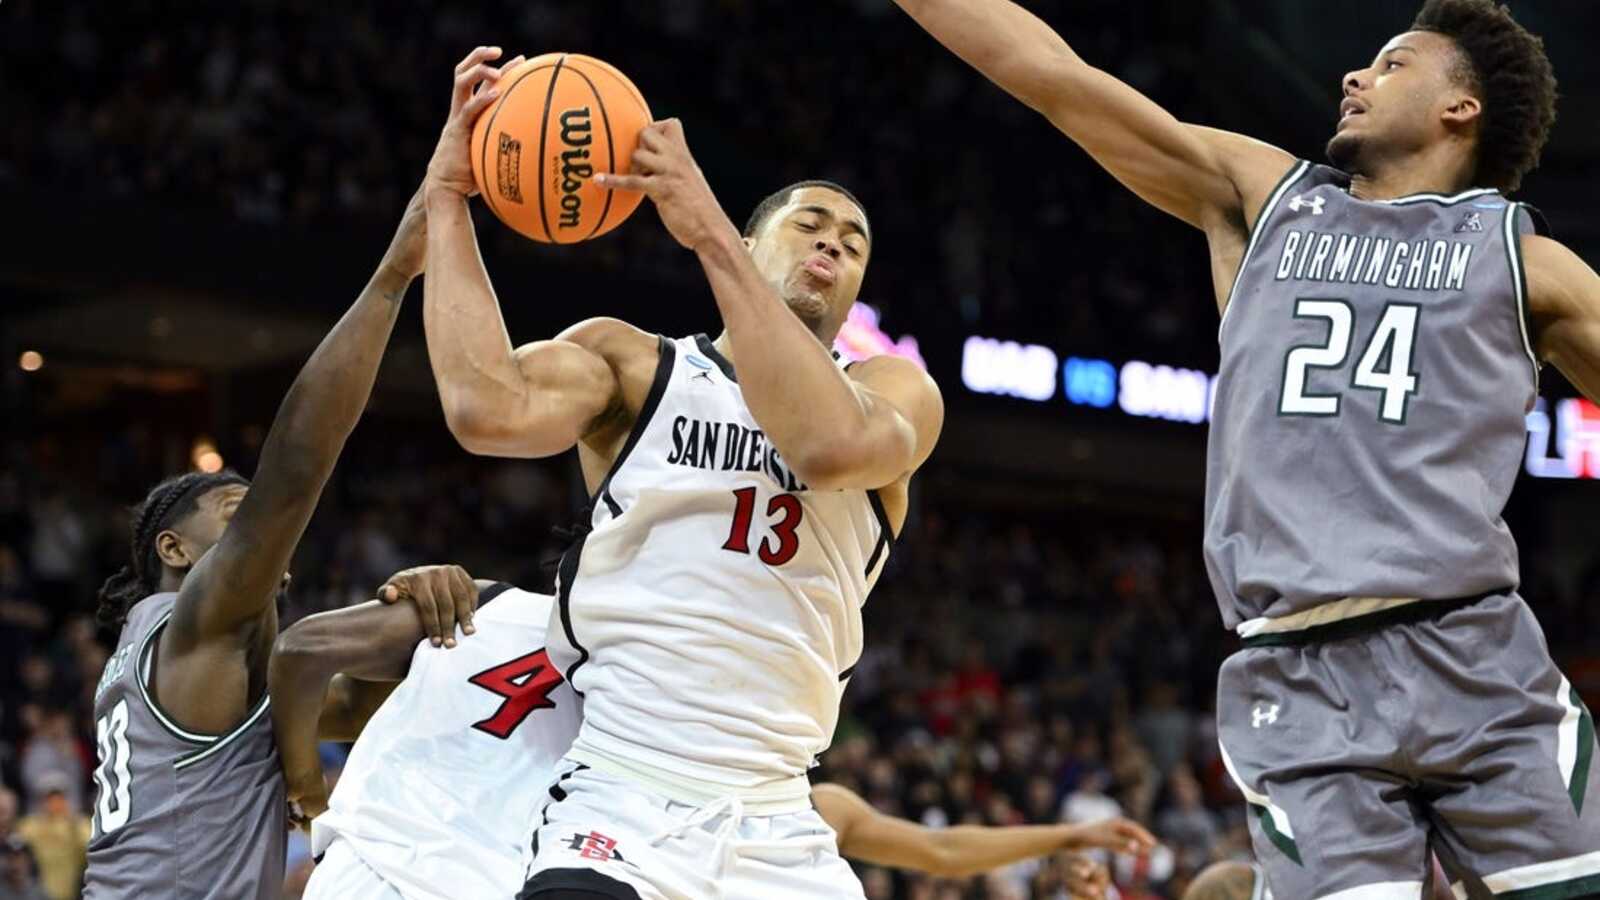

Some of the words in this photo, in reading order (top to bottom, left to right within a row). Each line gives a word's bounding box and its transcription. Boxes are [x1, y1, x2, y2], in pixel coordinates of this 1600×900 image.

[559, 107, 593, 228] Wilson
[1275, 231, 1473, 291] BIRMINGHAM
[1278, 297, 1422, 425] 24
[667, 415, 721, 470] SAN
[721, 423, 768, 473] DIE
[721, 486, 803, 566] 13
[467, 647, 565, 740] 4
